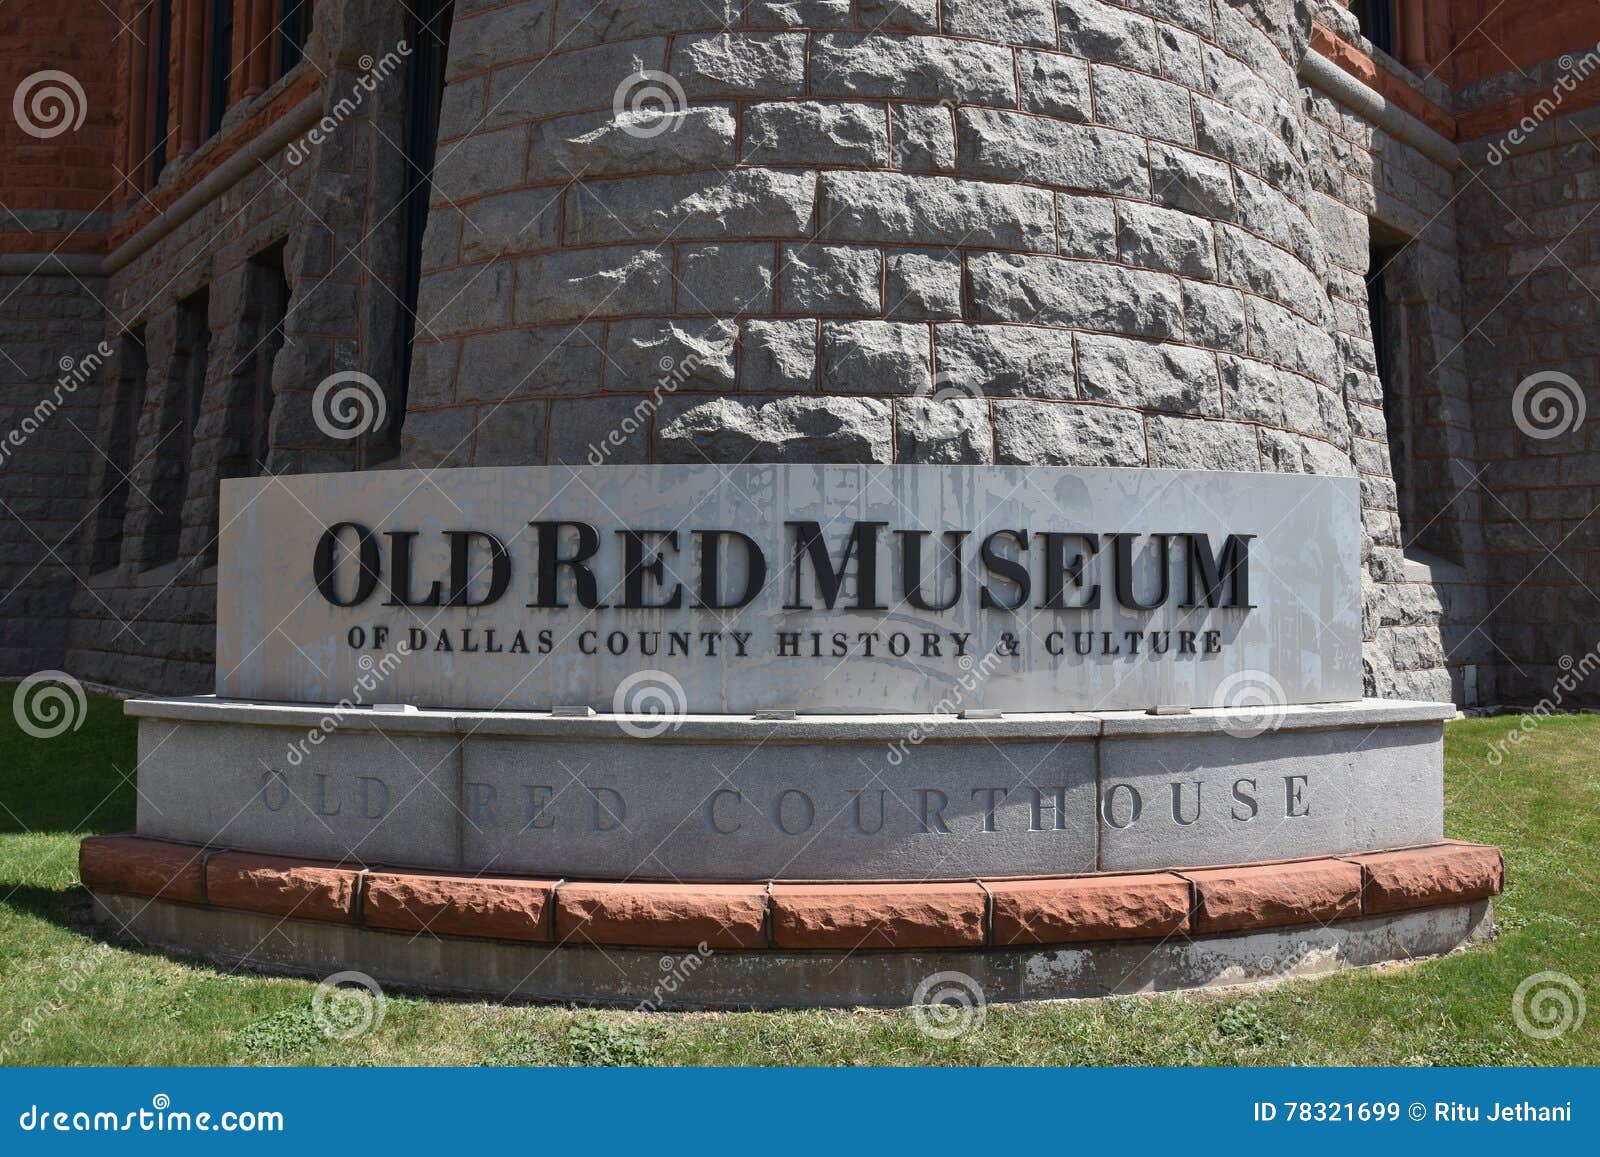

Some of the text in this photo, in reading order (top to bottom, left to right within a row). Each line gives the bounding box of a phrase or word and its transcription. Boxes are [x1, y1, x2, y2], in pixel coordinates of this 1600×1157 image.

[313, 520, 1258, 611] OLD RED MUSEUM
[347, 626, 1223, 658] OF DALLAS COUNTY HISTORY & CULTURE
[256, 768, 1311, 835] OLD RED COURTHOUSE
